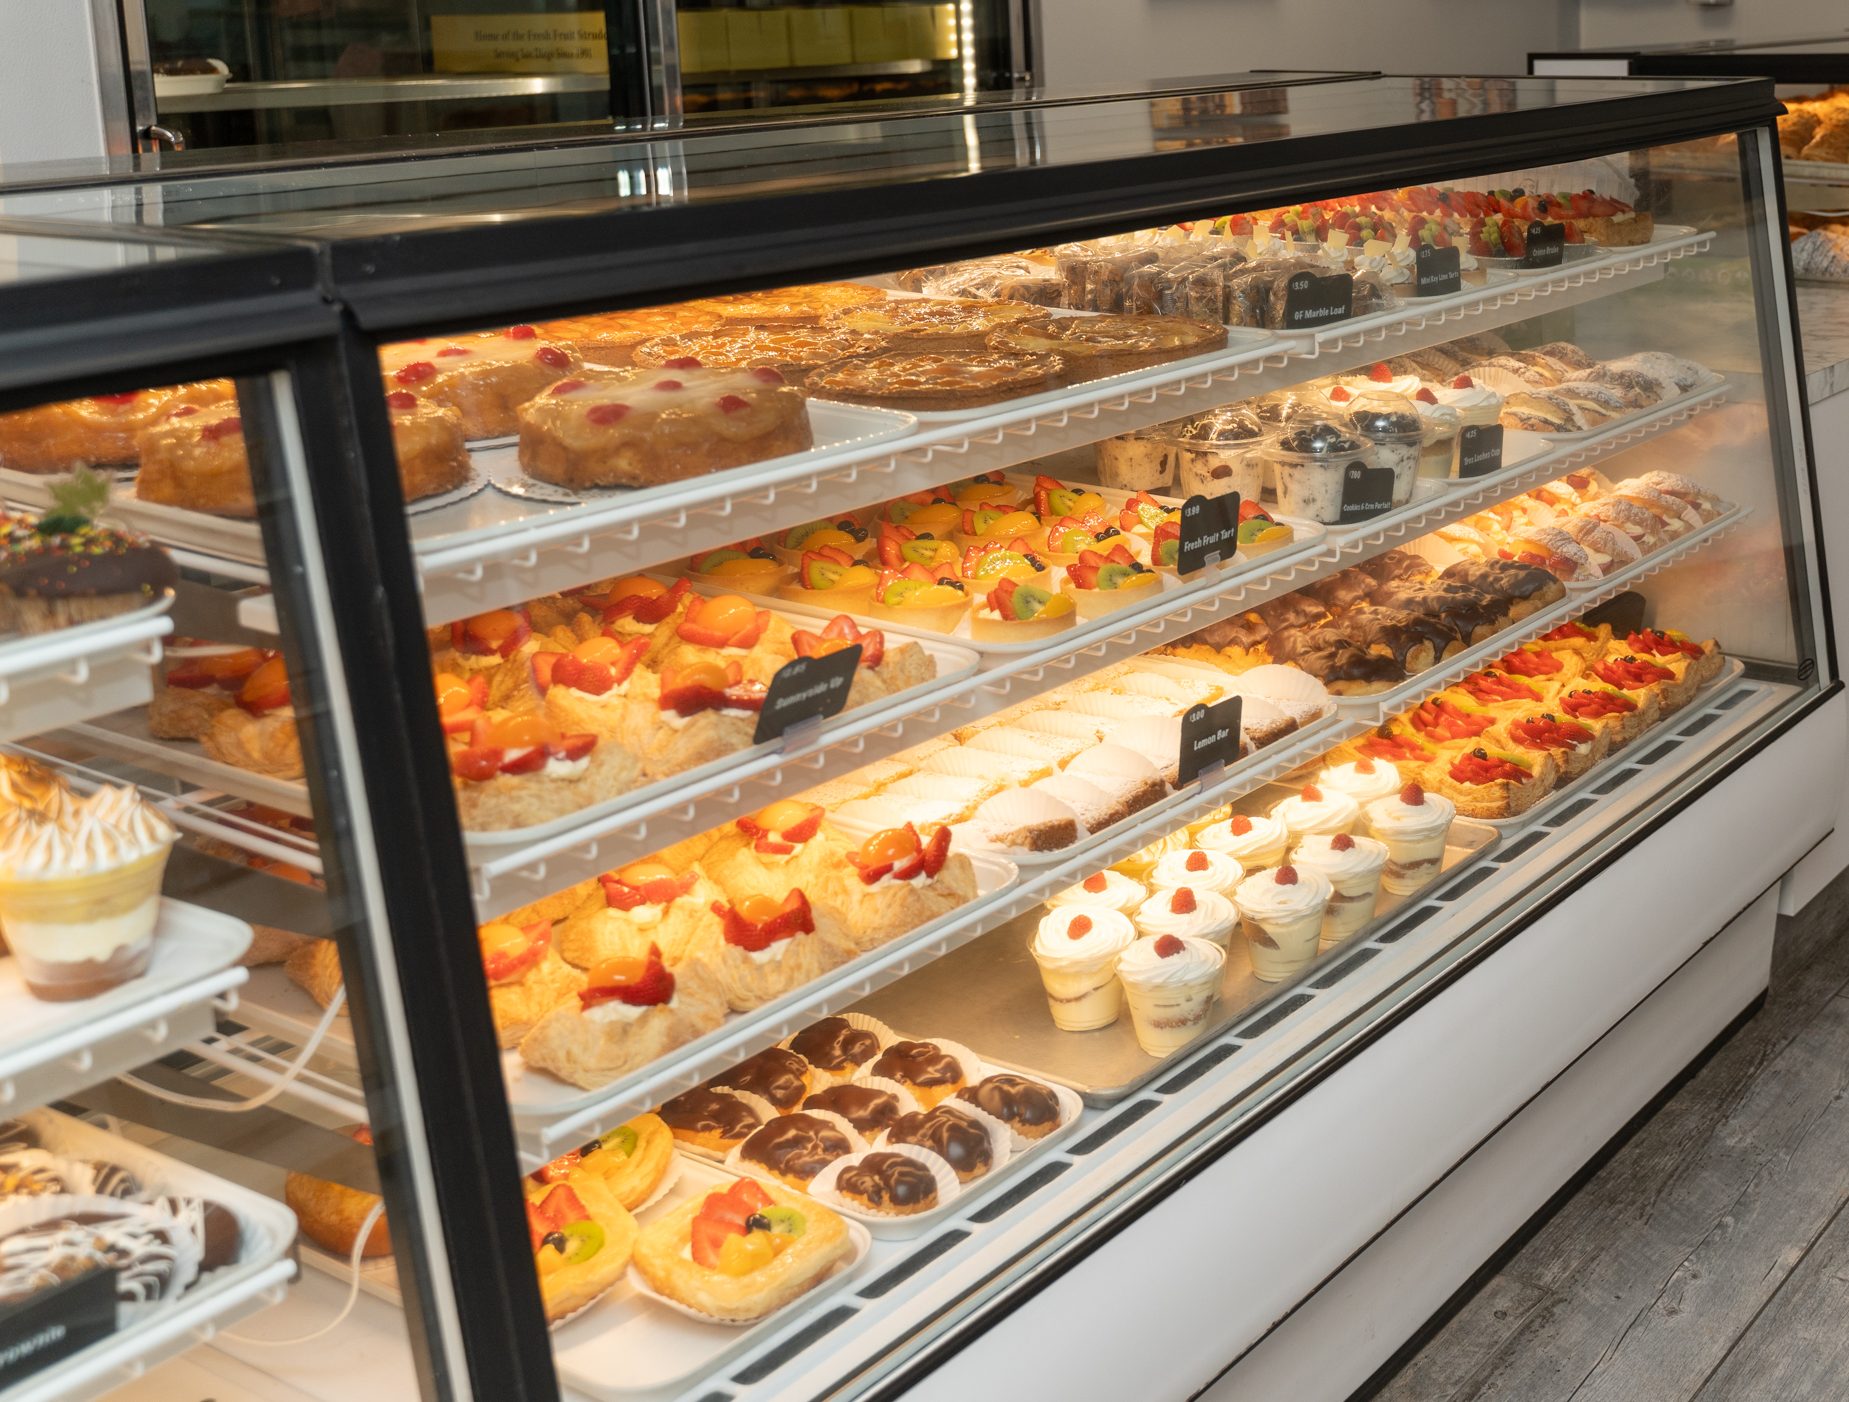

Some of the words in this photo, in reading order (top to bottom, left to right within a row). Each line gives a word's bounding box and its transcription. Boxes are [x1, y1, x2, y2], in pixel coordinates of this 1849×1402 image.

[1304, 307, 1329, 319] Marble
[1330, 304, 1345, 315] Loaf
[1343, 503, 1361, 512] Cookies
[1184, 537, 1202, 552] Fresh
[1203, 532, 1219, 546] Fruit
[1220, 527, 1234, 540] Tart
[1193, 735, 1216, 751] Lemon
[1216, 728, 1230, 741] Bar
